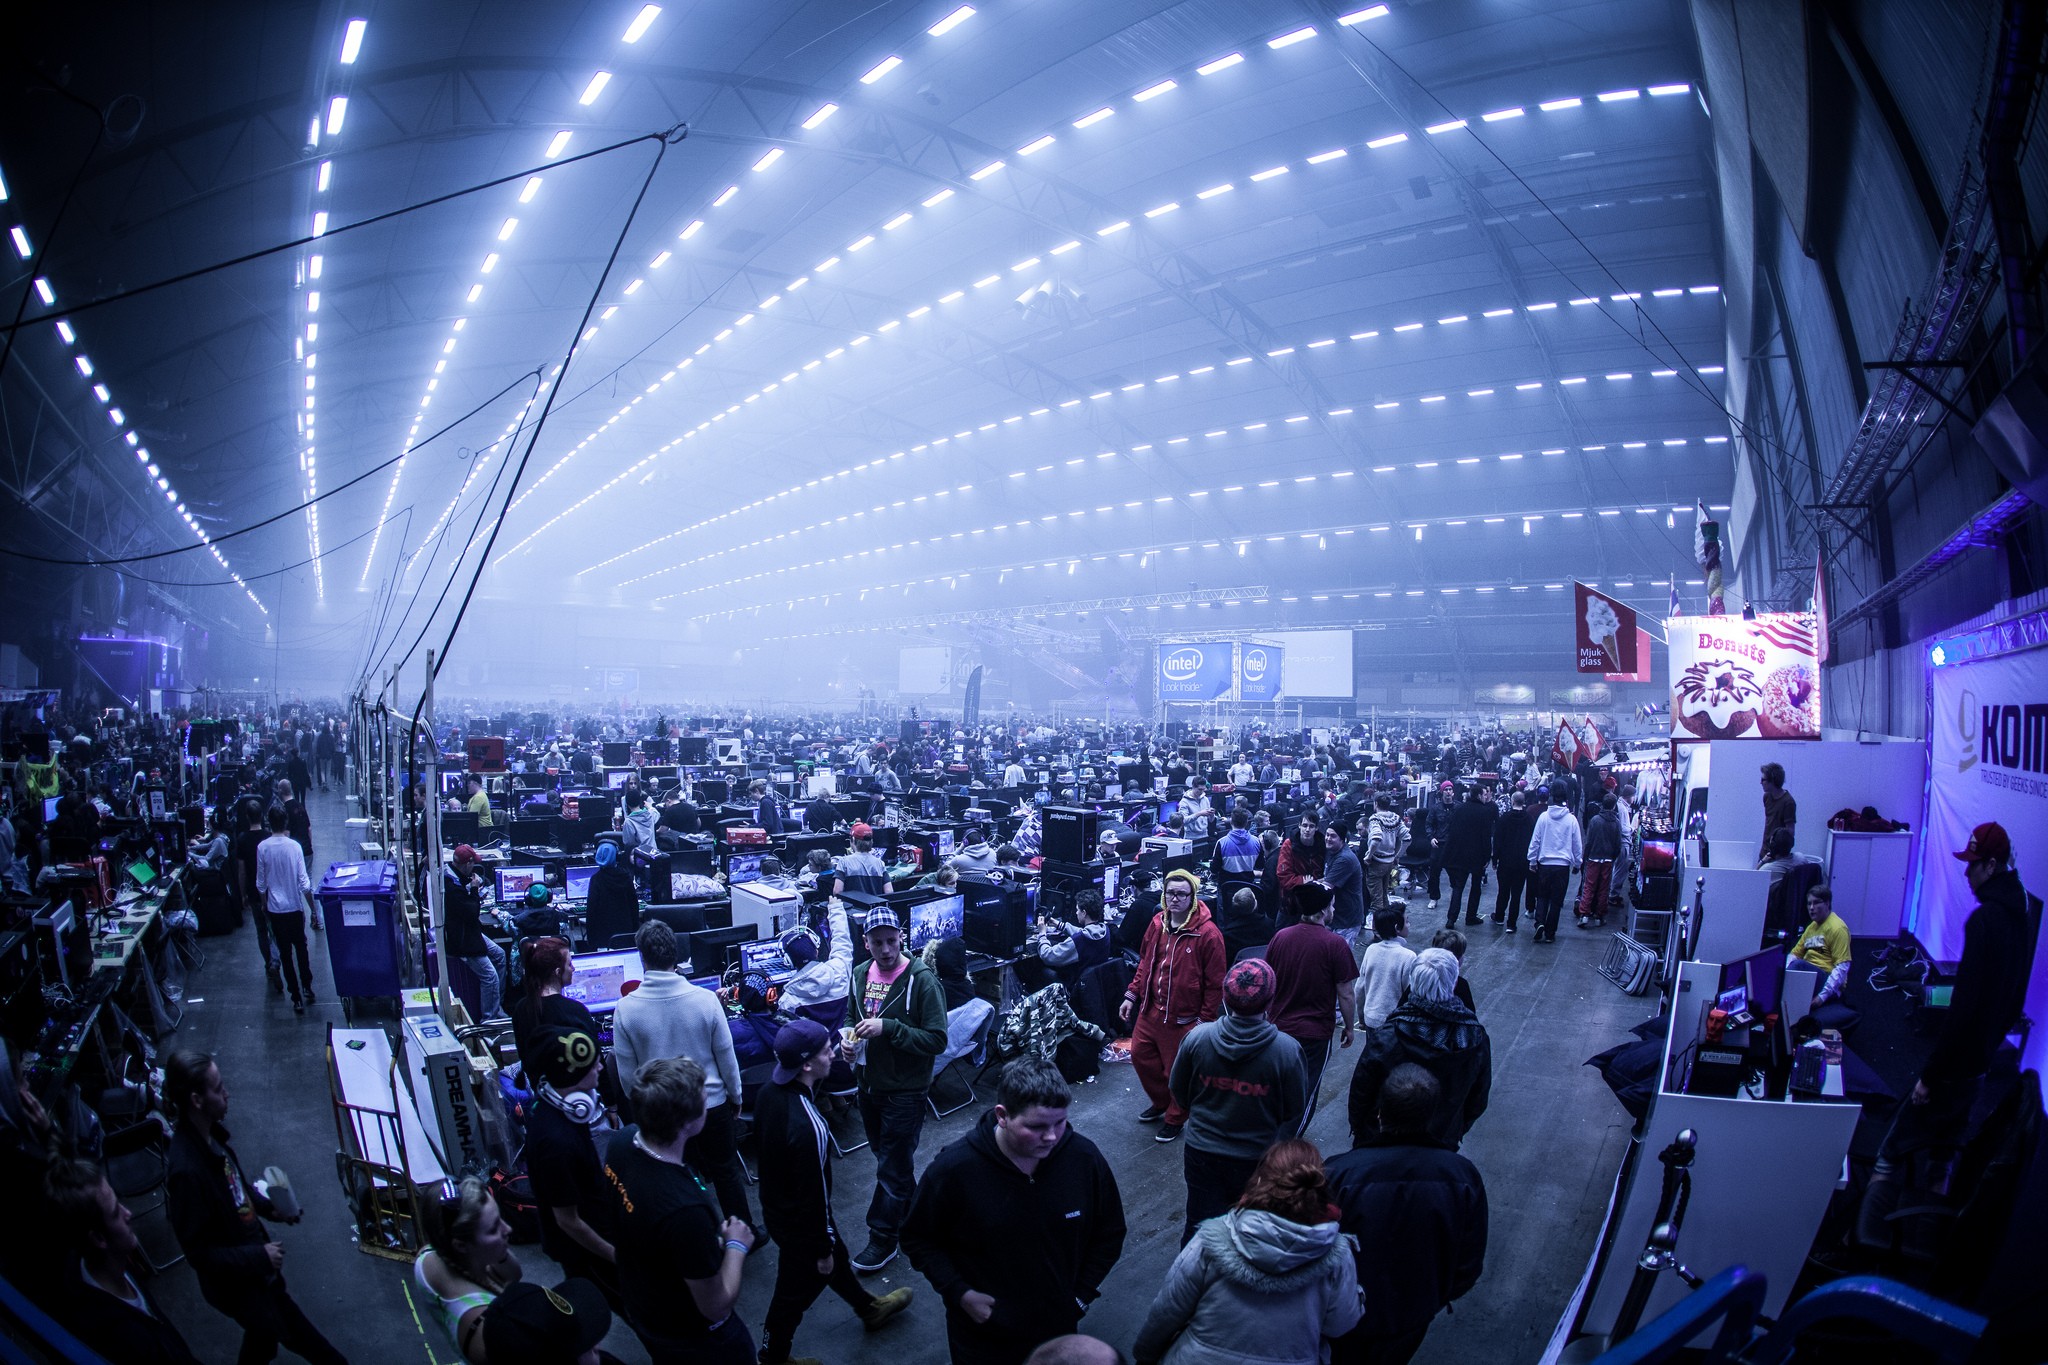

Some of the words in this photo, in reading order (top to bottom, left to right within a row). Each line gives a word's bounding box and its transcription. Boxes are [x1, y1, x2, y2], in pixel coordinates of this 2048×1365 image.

[1580, 648, 1605, 658] Mjuk-
[1698, 633, 1766, 665] Donuts
[1168, 655, 1197, 670] intel
[1246, 656, 1264, 672] intel
[1580, 657, 1602, 667] glass
[1162, 681, 1179, 692] Look
[1244, 683, 1254, 693] Look
[1981, 769, 2002, 787] TRUSTED
[2010, 775, 2029, 795] GEEKS
[2029, 779, 2048, 799] SINCE
[1199, 1073, 1270, 1097] VISION
